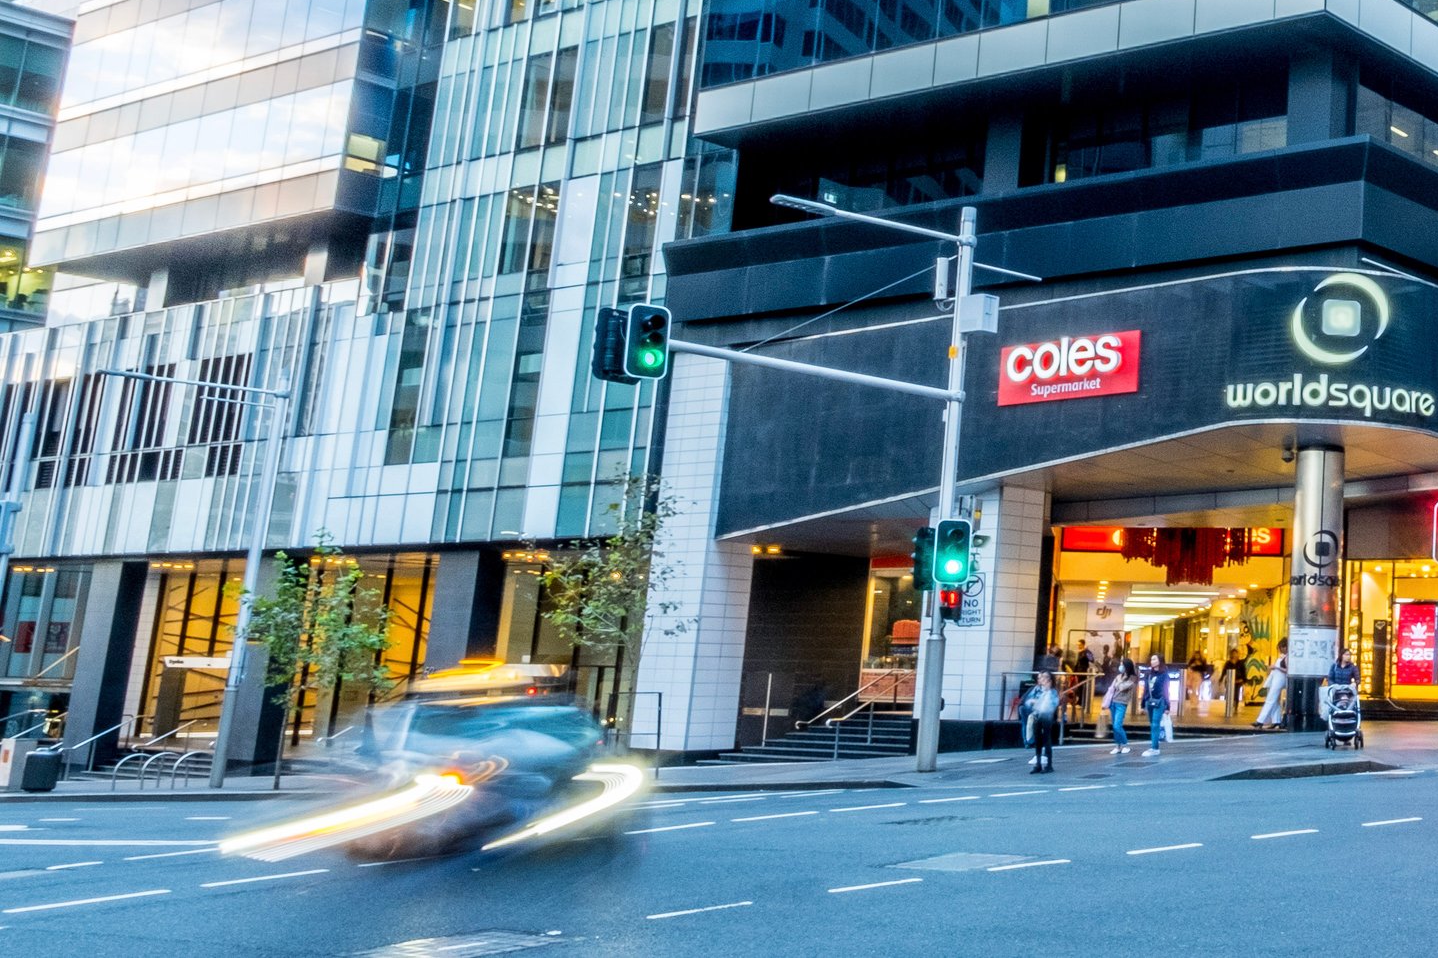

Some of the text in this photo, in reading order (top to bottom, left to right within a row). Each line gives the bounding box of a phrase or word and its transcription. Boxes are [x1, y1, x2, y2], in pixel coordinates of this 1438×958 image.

[1007, 335, 1121, 382] coles
[1030, 378, 1101, 398] Supermarket
[1226, 373, 1435, 417] worldsquare
[963, 599, 979, 607] NO
[1401, 647, 1434, 661] $25
